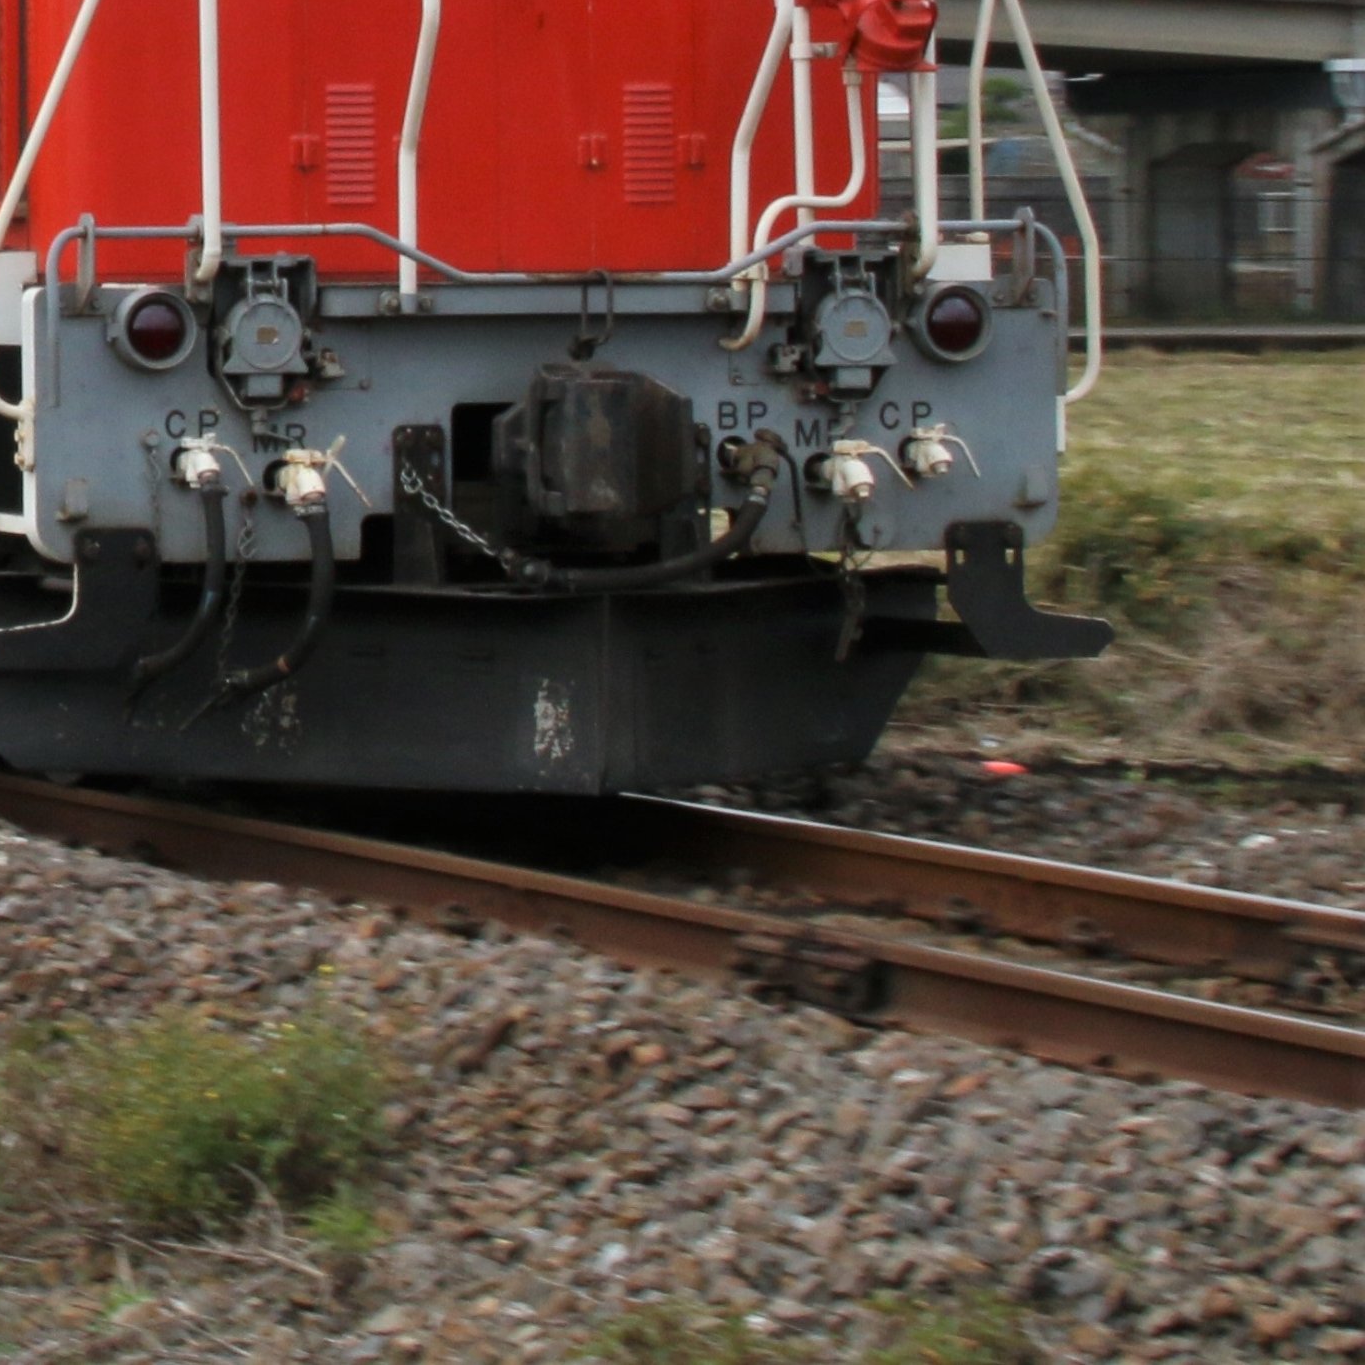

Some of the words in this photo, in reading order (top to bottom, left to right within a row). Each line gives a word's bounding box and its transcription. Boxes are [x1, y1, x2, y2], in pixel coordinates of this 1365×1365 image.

[165, 409, 219, 438] CP
[718, 401, 767, 429] BP
[879, 401, 931, 429] CP
